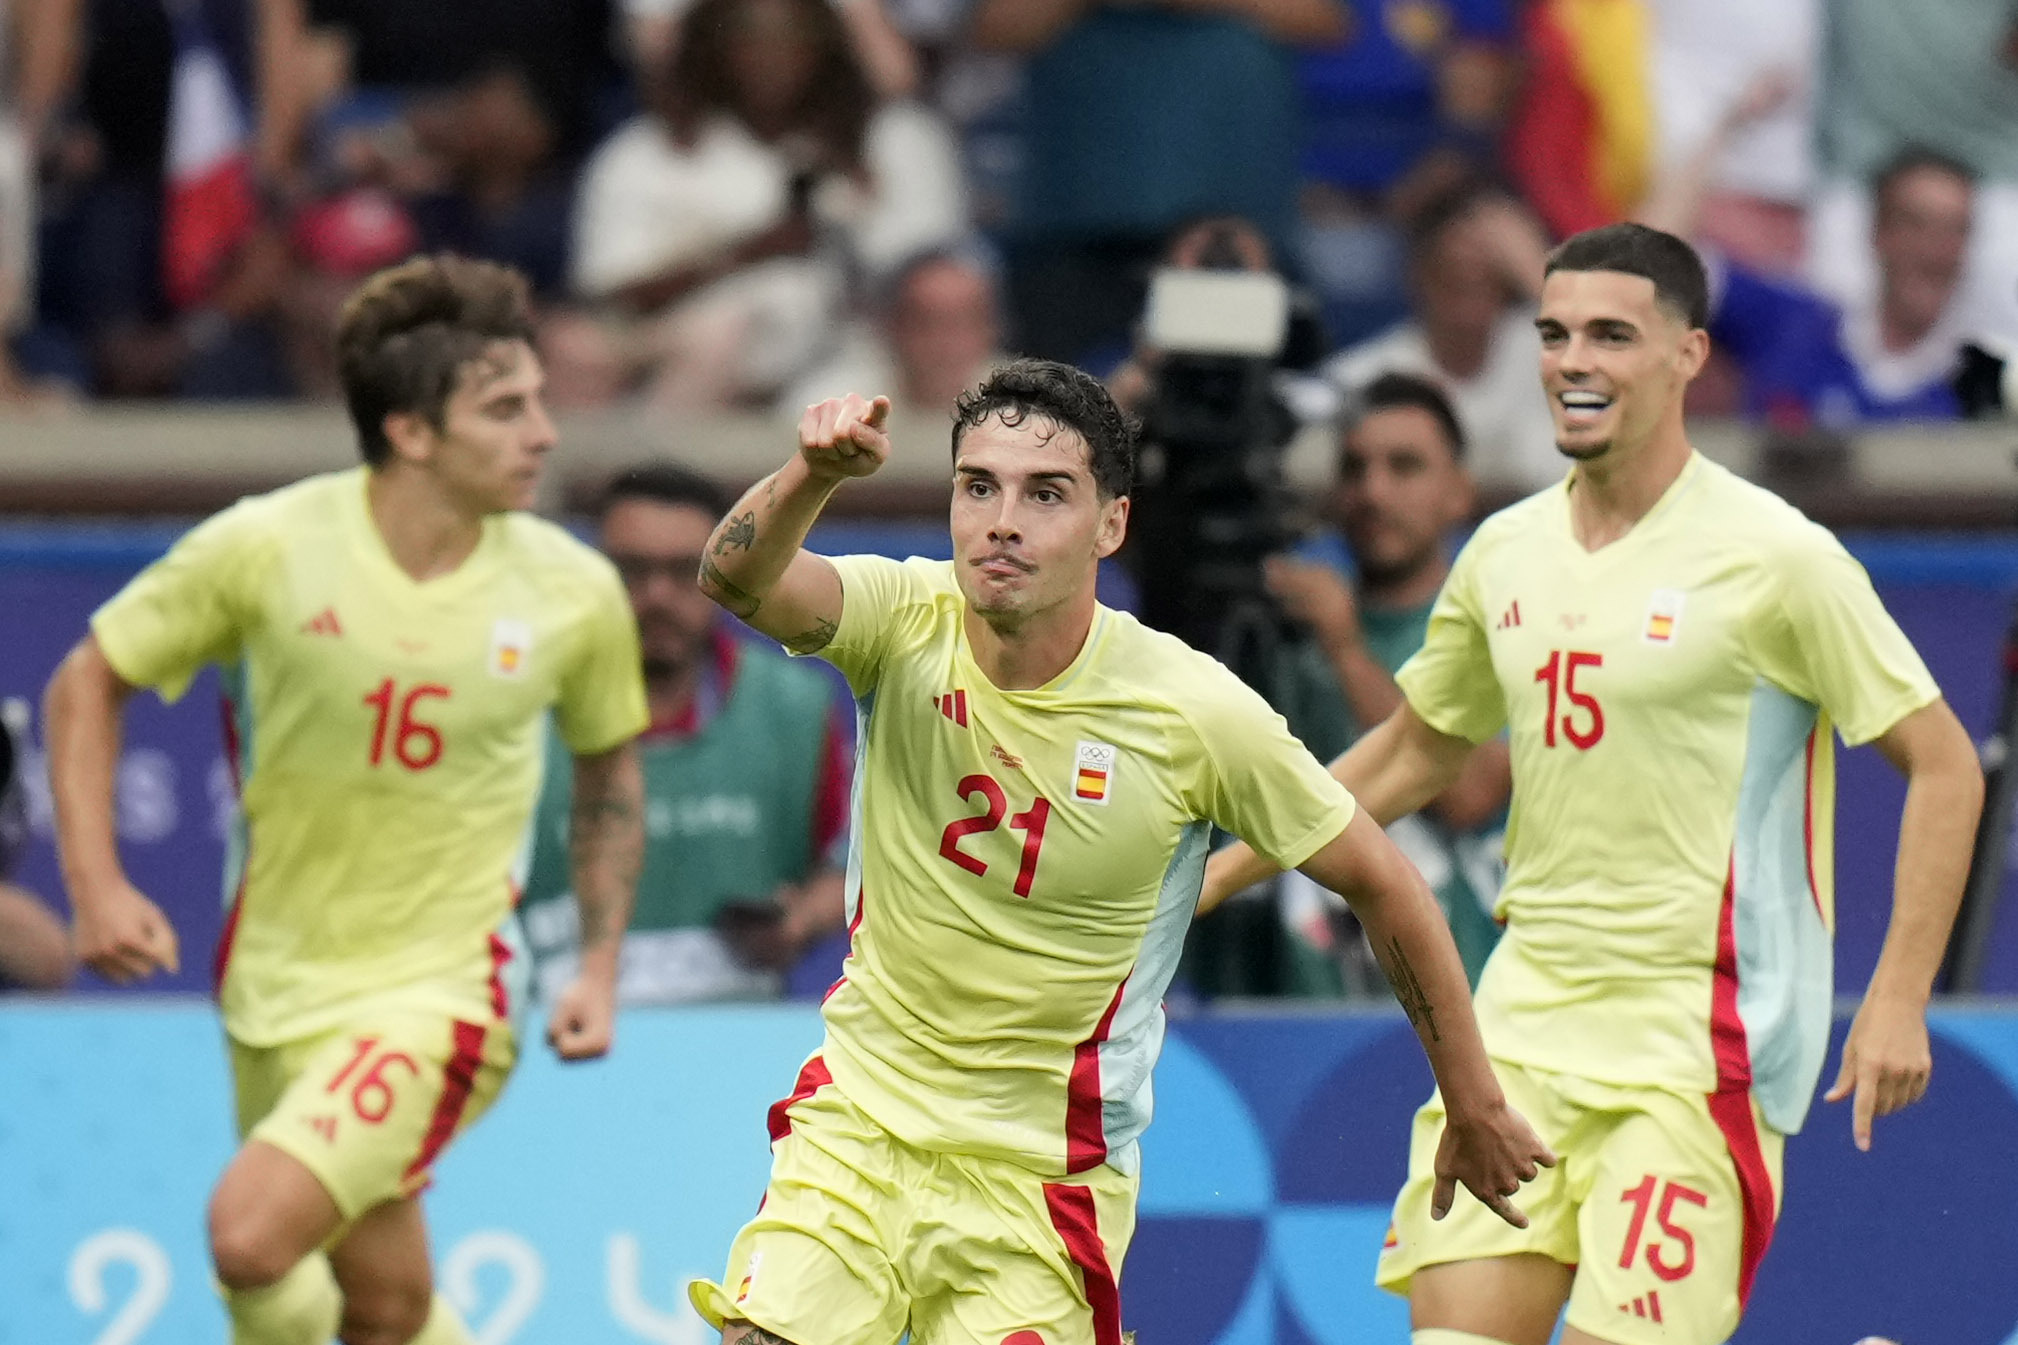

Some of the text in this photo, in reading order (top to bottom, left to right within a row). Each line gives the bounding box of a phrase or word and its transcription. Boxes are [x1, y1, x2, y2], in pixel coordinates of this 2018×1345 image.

[363, 677, 451, 772] 16
[1535, 650, 1605, 751] 15
[939, 774, 1050, 899] 21
[326, 1037, 420, 1124] 16
[1617, 1174, 1708, 1282] 15
